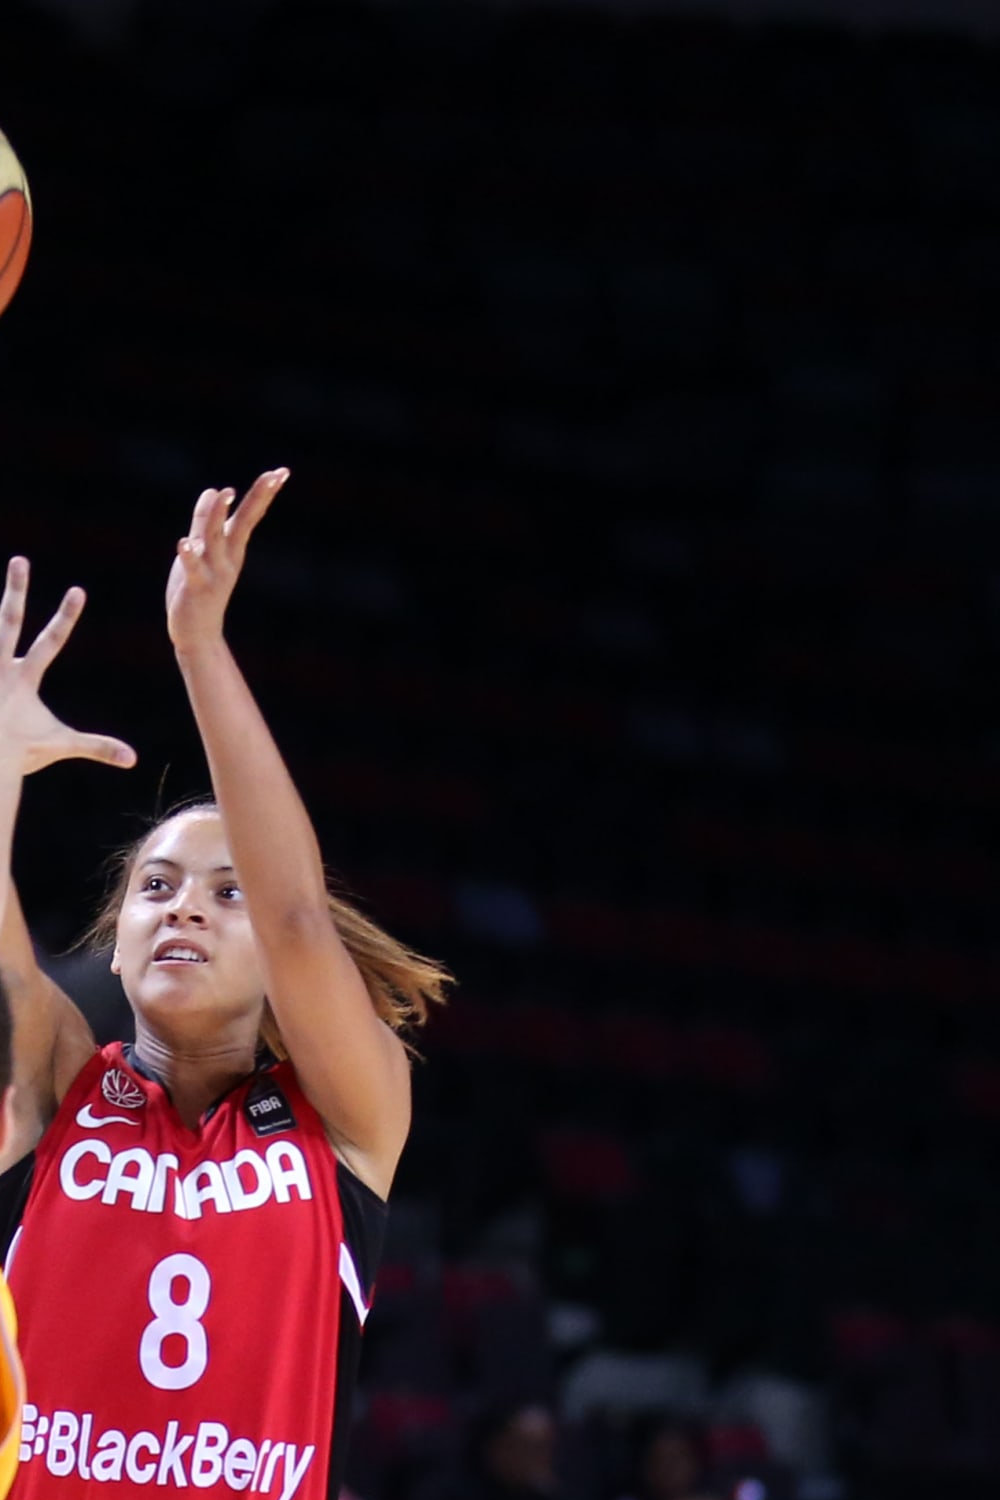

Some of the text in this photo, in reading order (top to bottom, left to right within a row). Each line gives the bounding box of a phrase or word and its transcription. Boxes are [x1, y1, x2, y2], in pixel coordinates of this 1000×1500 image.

[249, 1096, 282, 1117] FIBA
[59, 1138, 313, 1220] CANADA
[139, 1252, 212, 1391] 8
